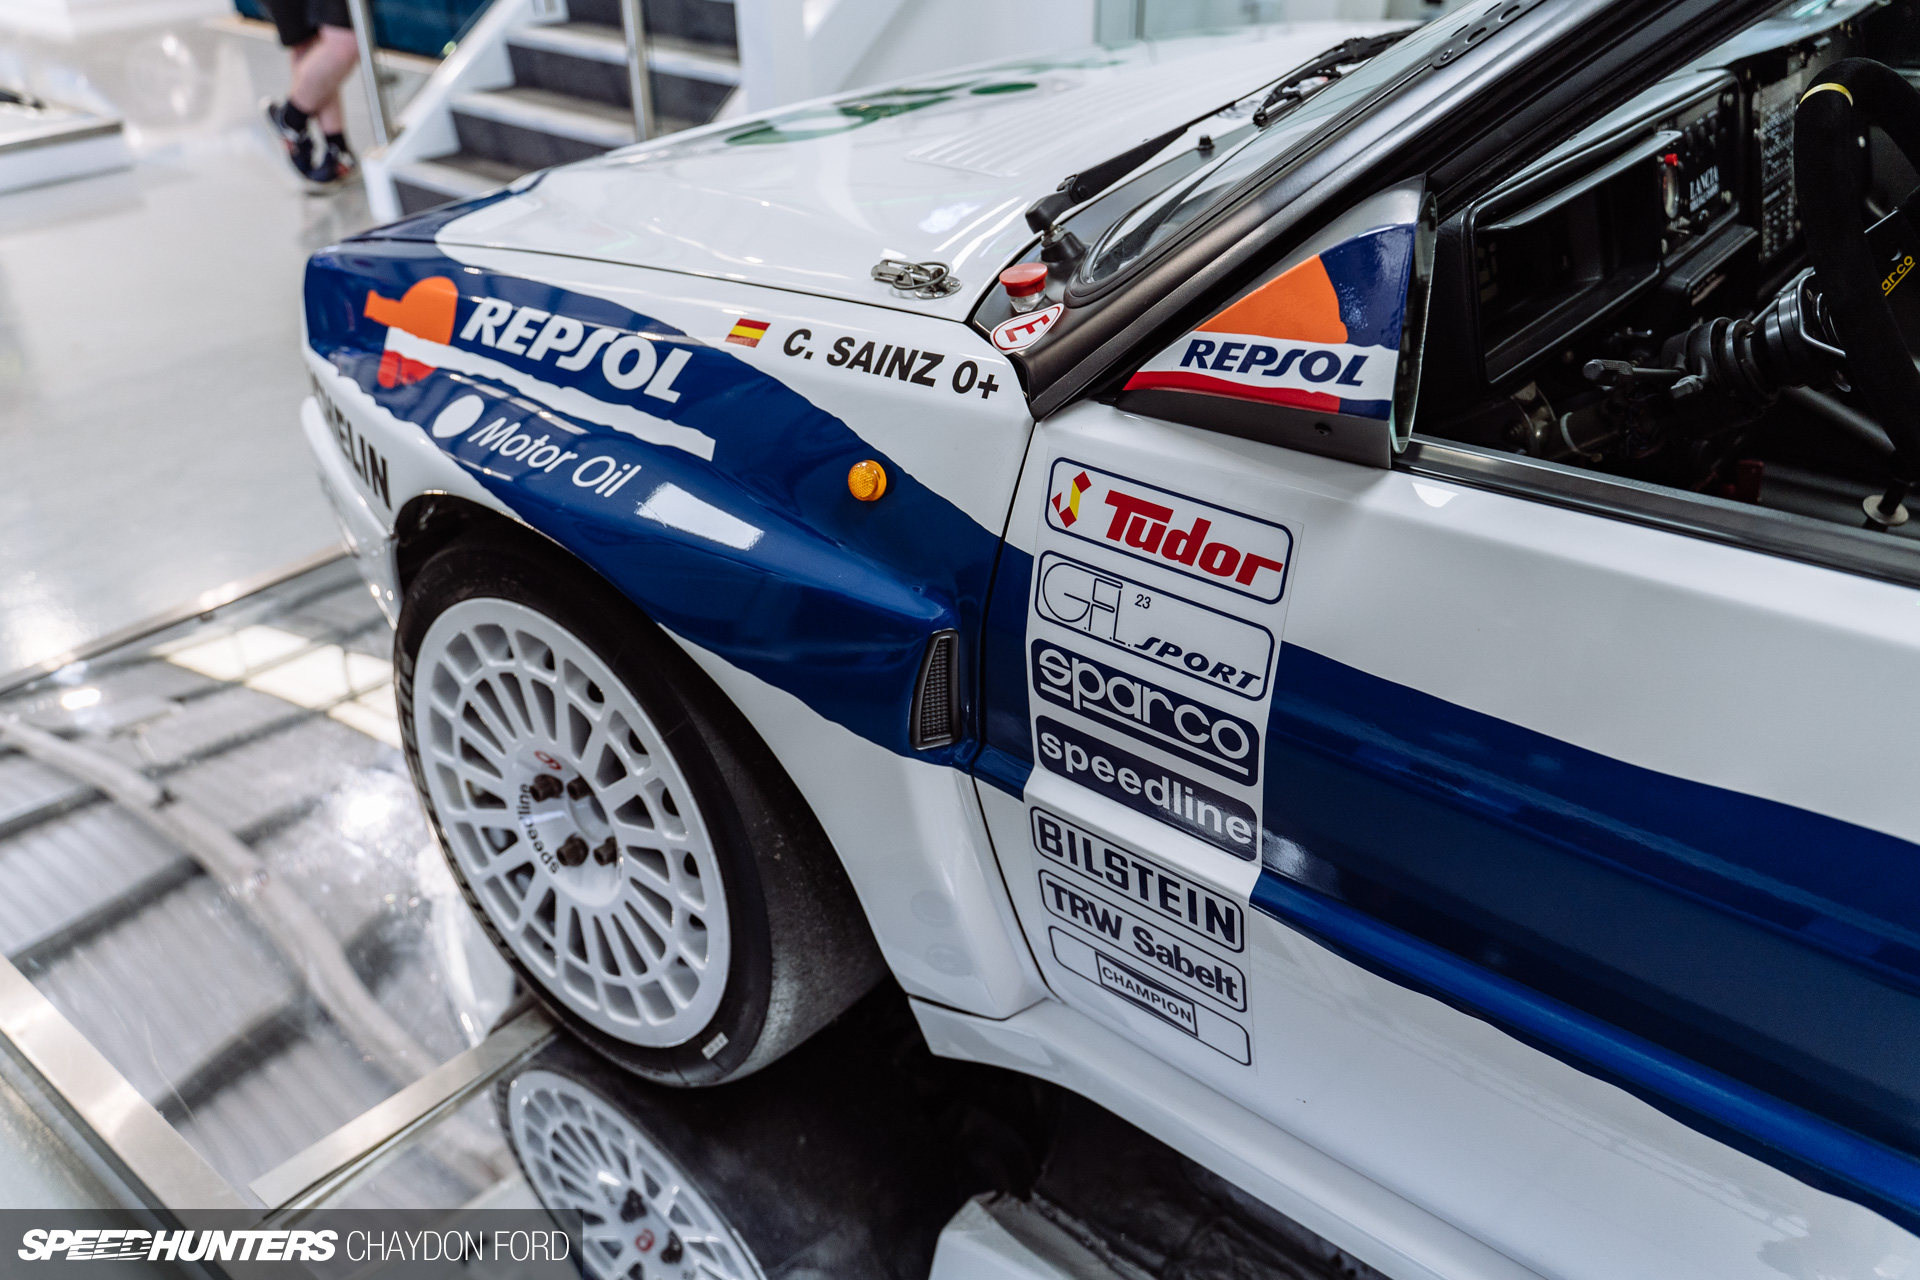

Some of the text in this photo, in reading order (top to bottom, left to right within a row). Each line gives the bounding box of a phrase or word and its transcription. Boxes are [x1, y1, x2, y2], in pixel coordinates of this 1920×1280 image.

[1881, 255, 1914, 291] arco
[460, 296, 693, 403] REPSOL
[783, 328, 813, 360] C.
[826, 336, 945, 388] SAINZ
[1179, 339, 1369, 387] REPSOL
[467, 417, 642, 498] Motor Oil
[1104, 489, 1284, 586] Tudor
[1134, 593, 1152, 610] 23
[1134, 636, 1261, 690] SPORT
[1038, 648, 1250, 760] sparco
[1040, 732, 1252, 844] speedline
[1037, 814, 1236, 945] BILSTEIN
[1046, 879, 1238, 1003] TRW Sabelt
[1102, 966, 1192, 1024] CHAMPION
